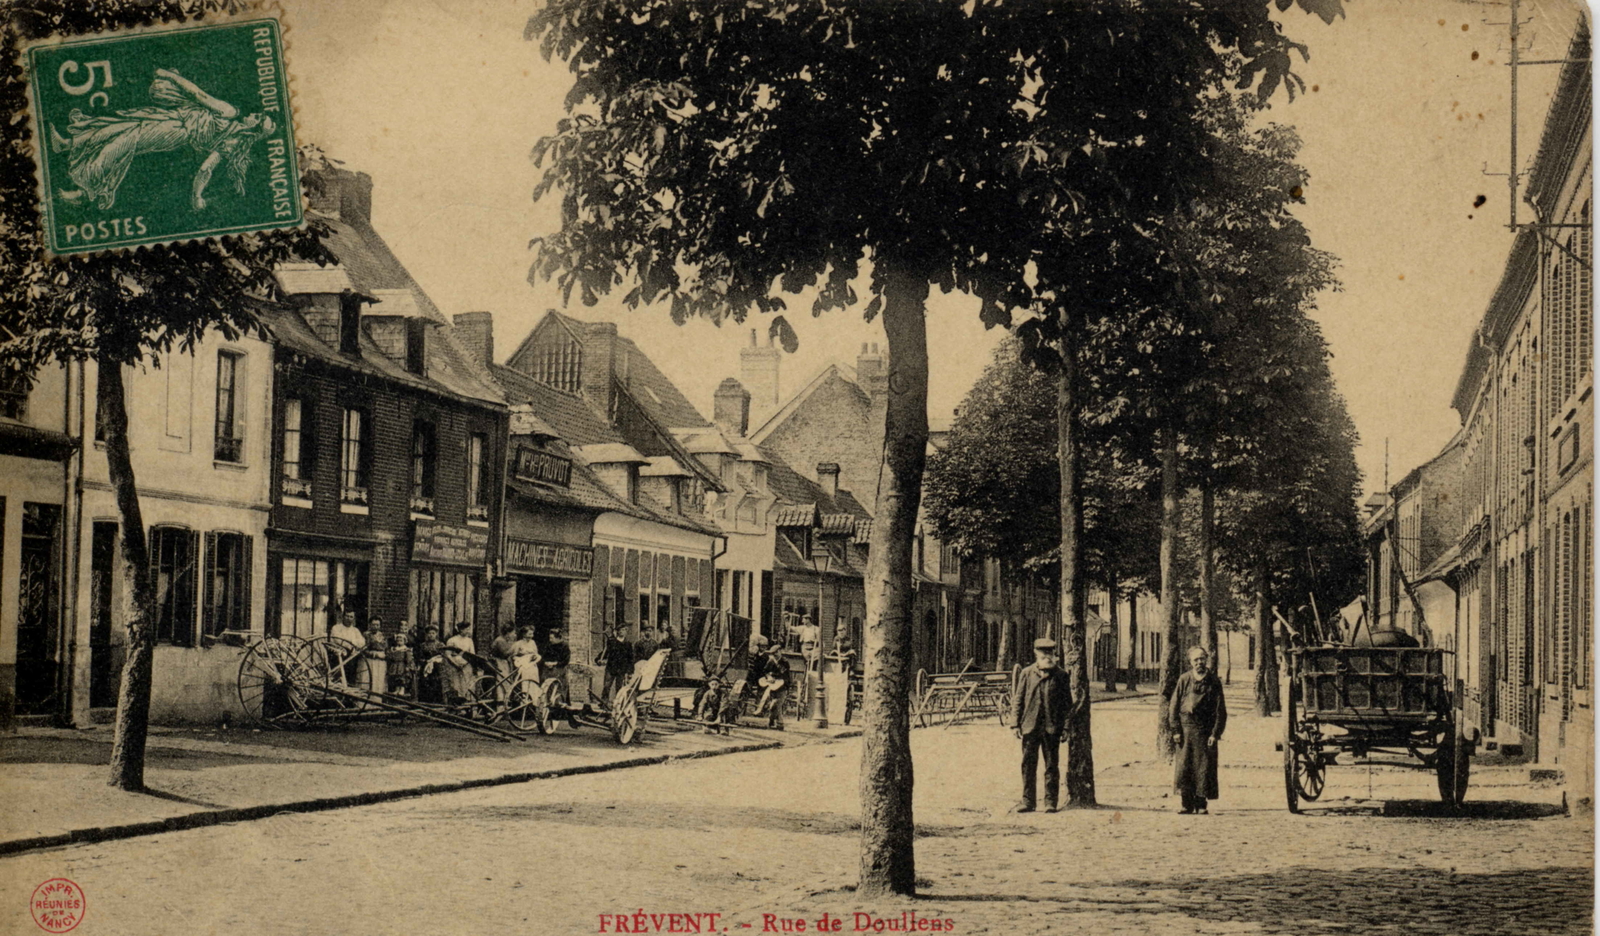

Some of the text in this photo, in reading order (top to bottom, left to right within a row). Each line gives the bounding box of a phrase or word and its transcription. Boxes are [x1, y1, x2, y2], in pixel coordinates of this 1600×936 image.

[253, 27, 292, 218] REPUBLIQUE FRANÇAISE
[65, 216, 147, 243] POSTES
[537, 454, 570, 483] PRUVOT
[507, 541, 548, 568] MACHINES
[551, 547, 592, 573] AGRICOLES
